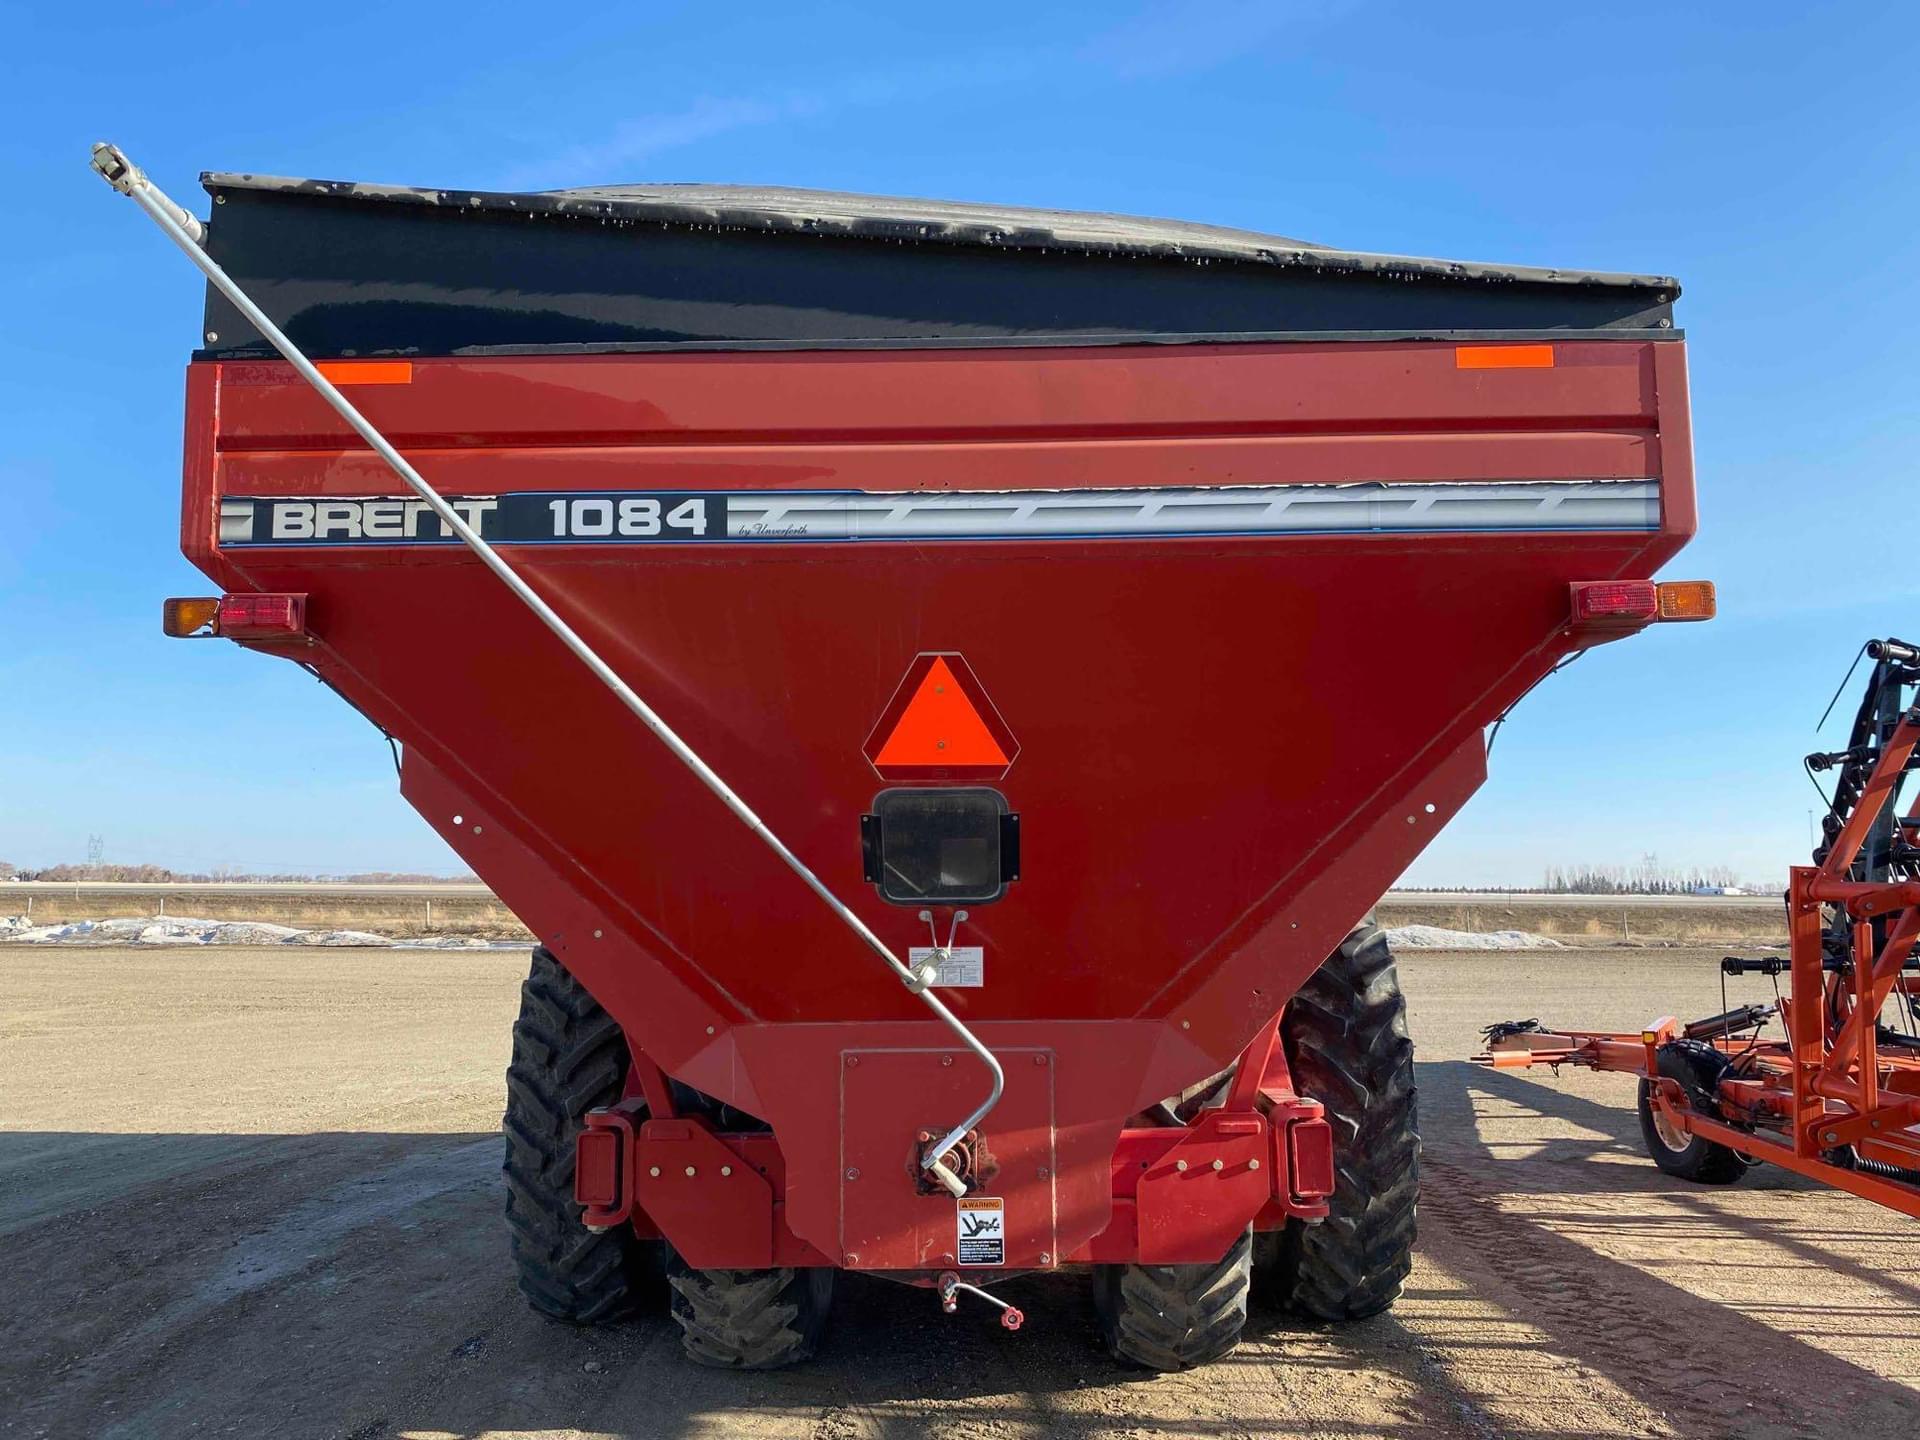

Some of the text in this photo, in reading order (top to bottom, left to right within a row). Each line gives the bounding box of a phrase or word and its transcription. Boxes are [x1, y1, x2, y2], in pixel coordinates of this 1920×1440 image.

[272, 499, 707, 539] BRENT 1084
[738, 525, 751, 537] by
